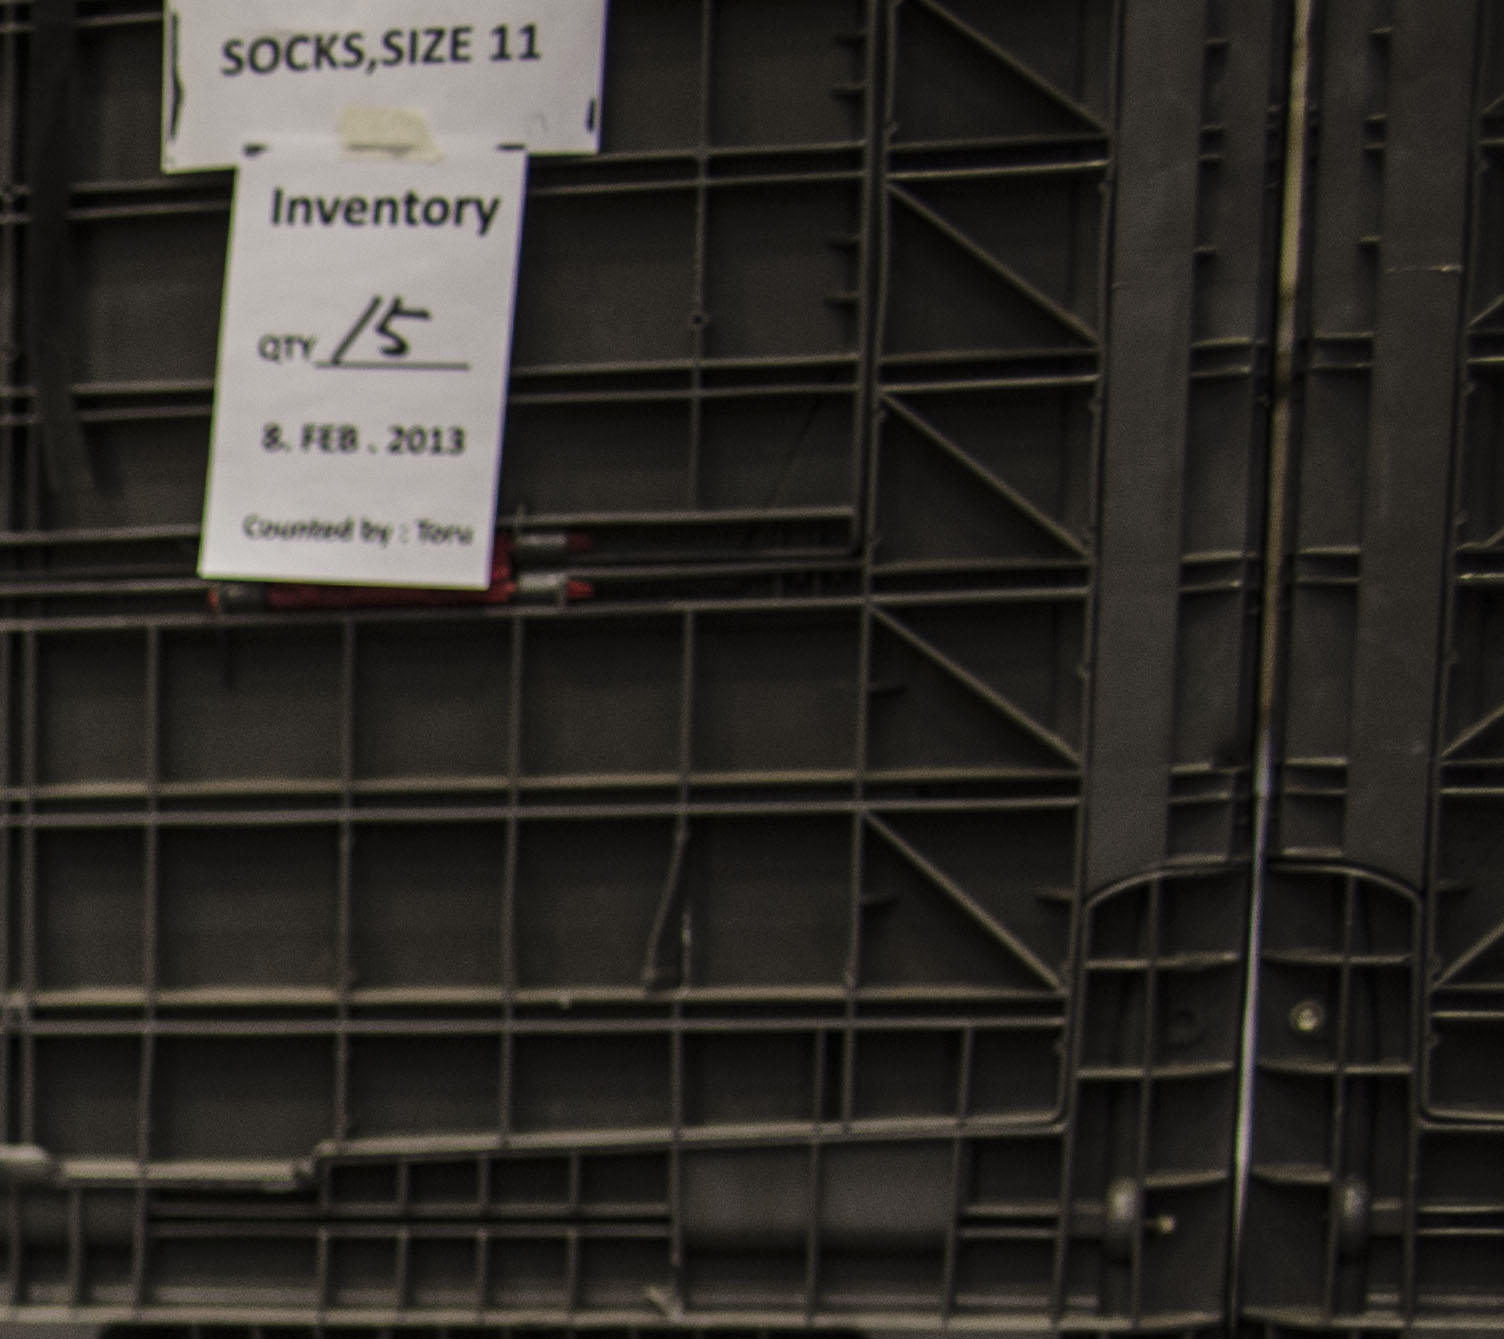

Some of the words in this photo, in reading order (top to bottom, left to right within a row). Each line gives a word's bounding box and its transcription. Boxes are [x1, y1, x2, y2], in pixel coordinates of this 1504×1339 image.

[222, 25, 472, 77] SOCKS,SIZE
[490, 23, 541, 62] 11
[271, 187, 501, 237] Inventory
[257, 334, 317, 363] QTY
[329, 296, 431, 363] 15
[300, 423, 359, 454] FEB
[387, 425, 466, 456] 2013
[242, 514, 355, 541] Counted
[359, 519, 392, 546] by
